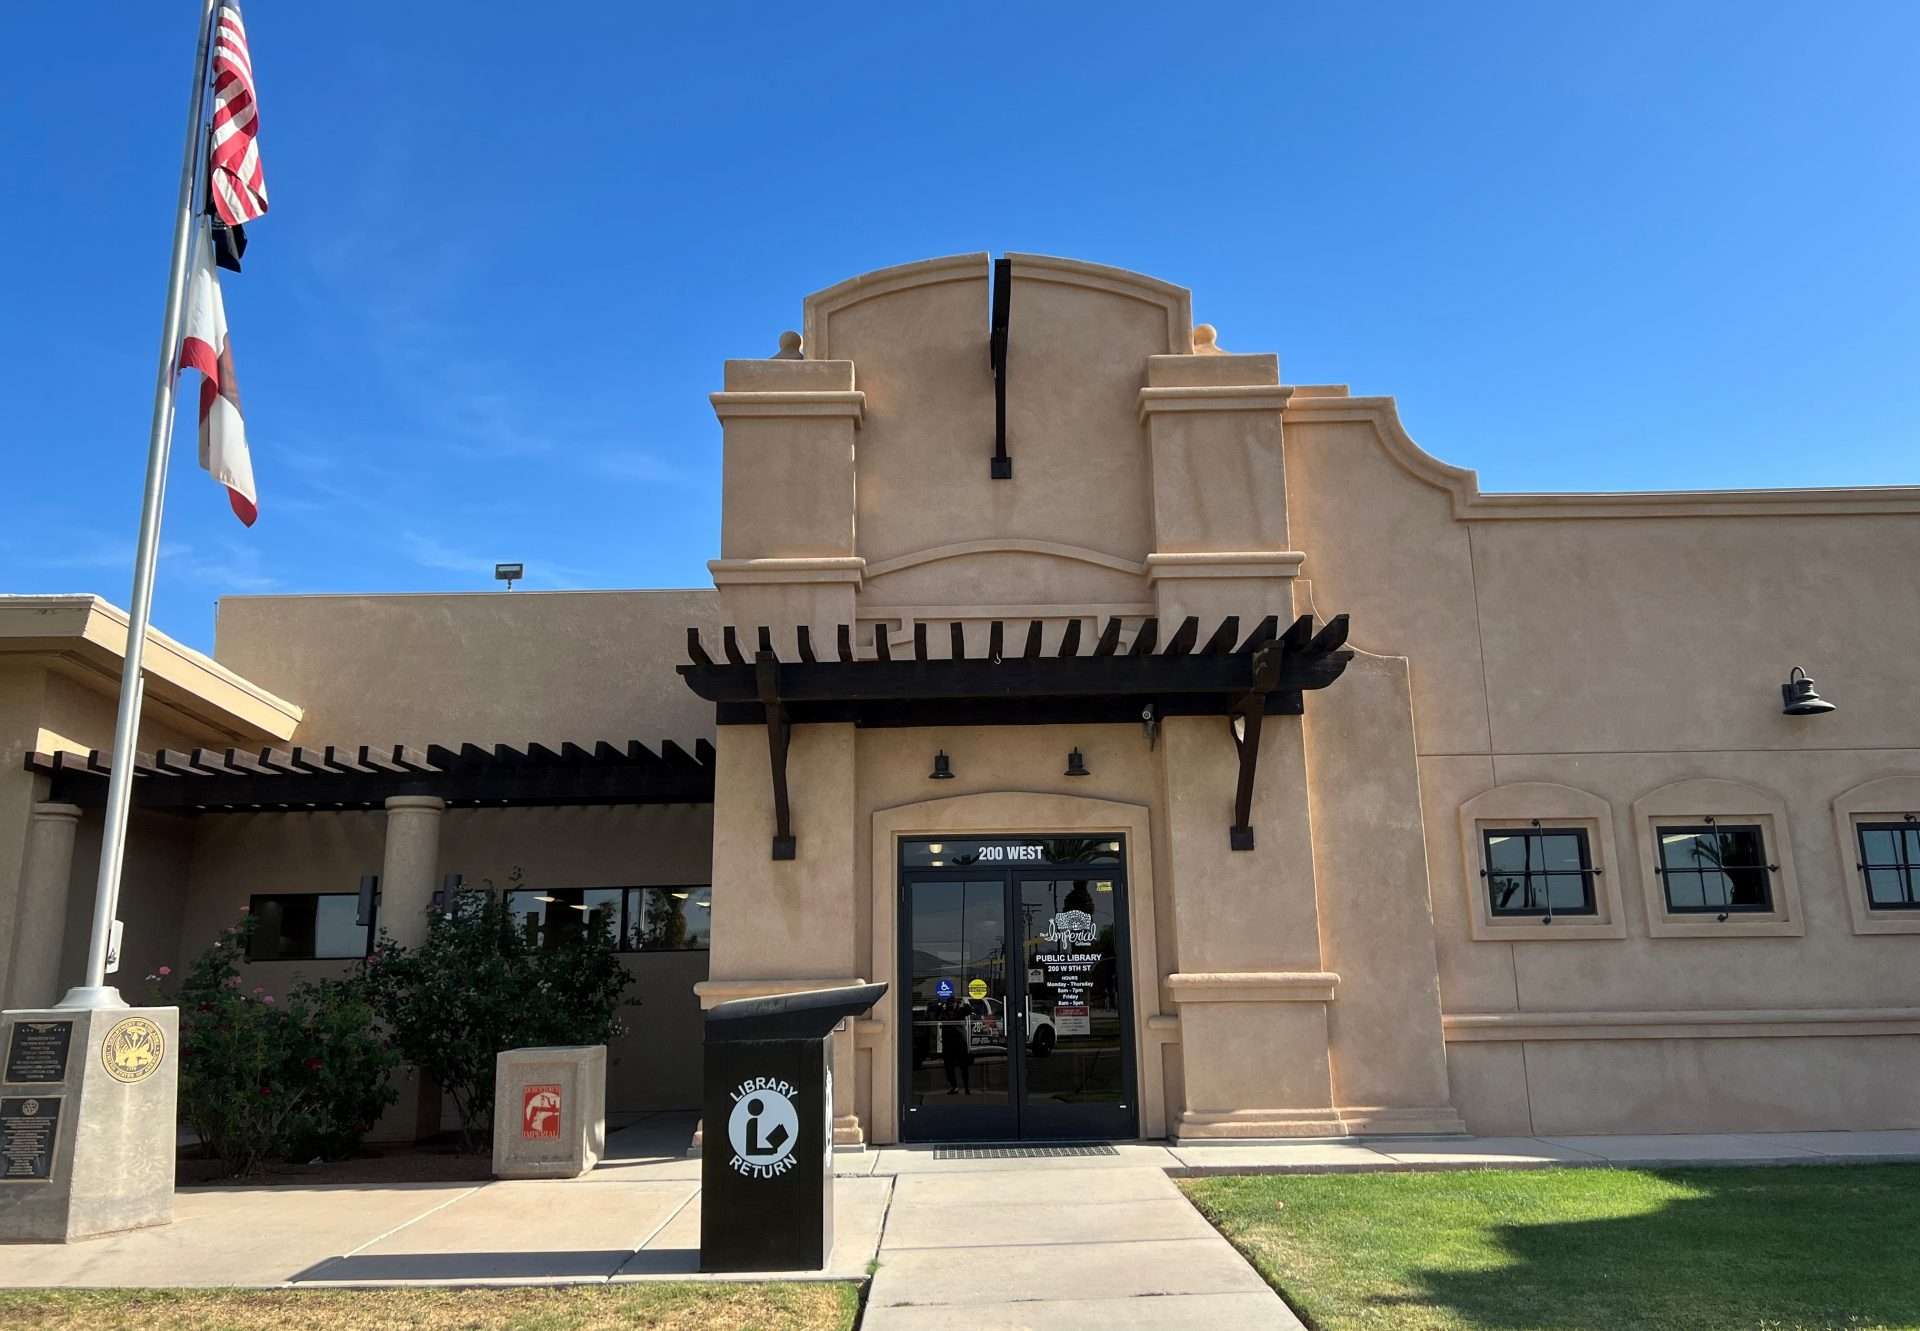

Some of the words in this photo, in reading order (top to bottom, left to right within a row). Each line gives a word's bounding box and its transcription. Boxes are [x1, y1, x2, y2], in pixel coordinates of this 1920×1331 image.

[978, 846, 1003, 860] 200
[1006, 846, 1044, 860] WEST
[1044, 919, 1096, 949] Imperial
[1036, 954, 1065, 962] PUBLIC
[1067, 953, 1101, 961] LIBRARY
[1082, 964, 1091, 972] ST
[730, 1077, 798, 1102] LIBRARY
[729, 1153, 798, 1178] RETURN
